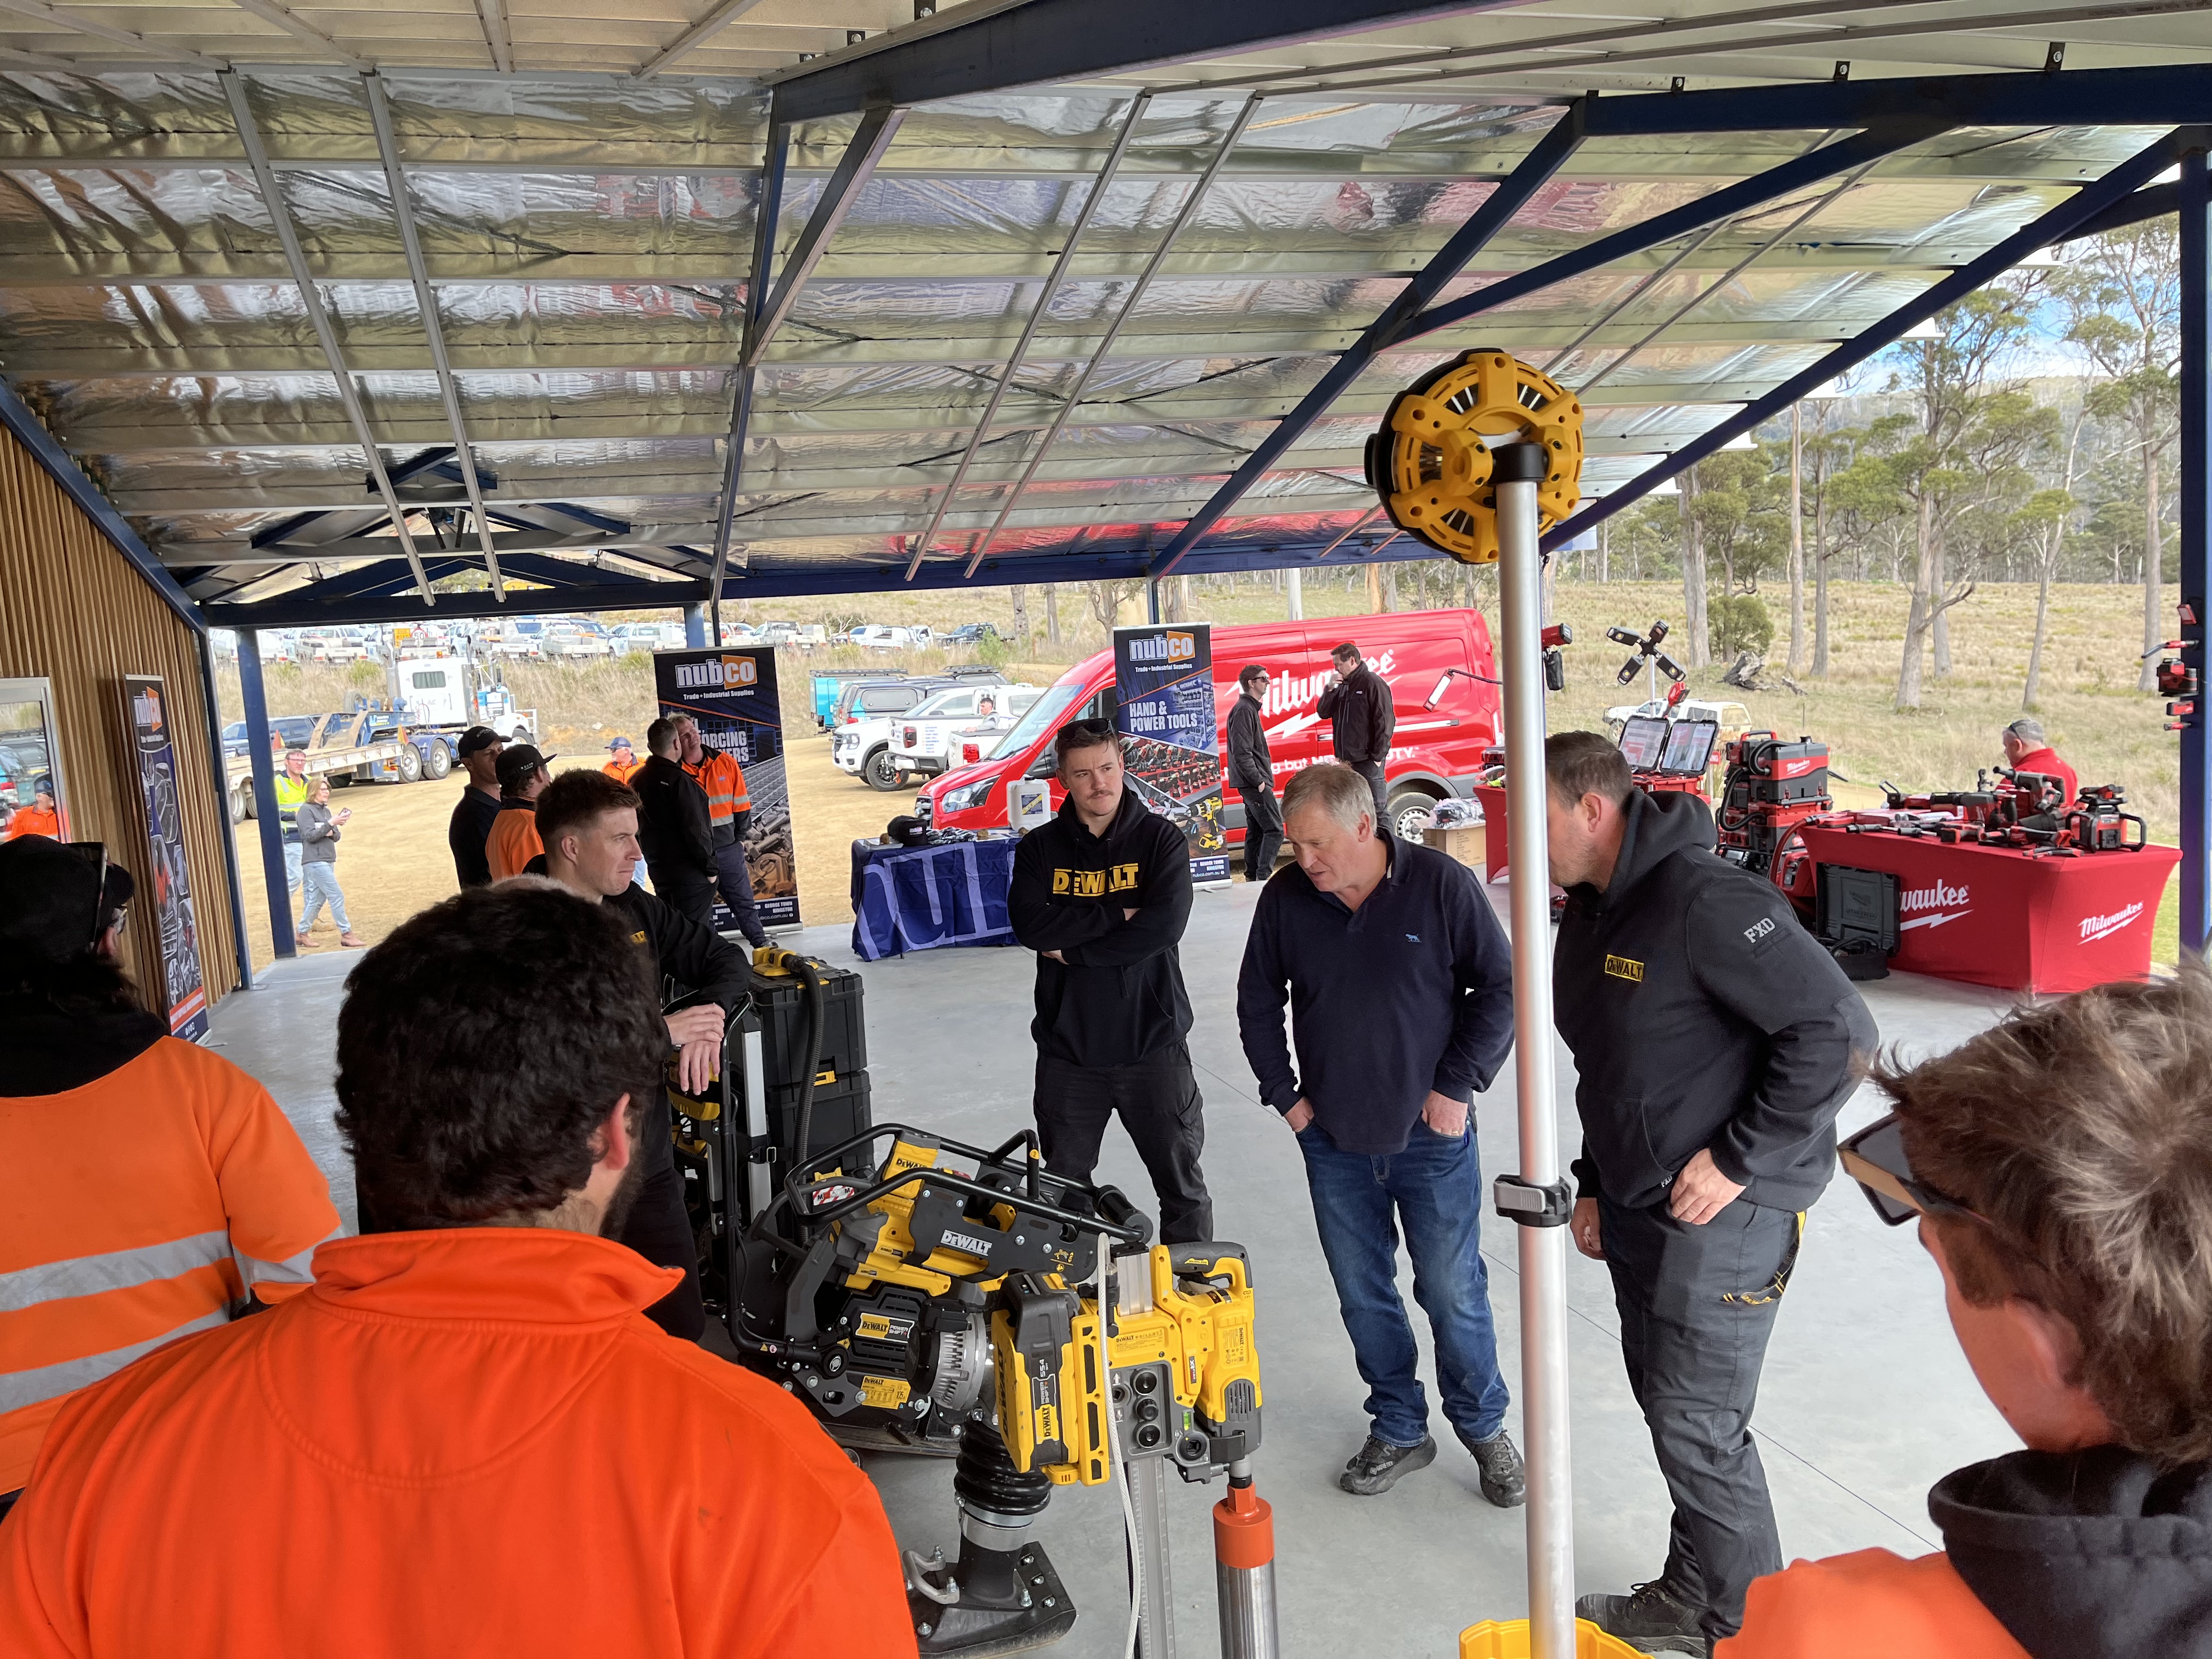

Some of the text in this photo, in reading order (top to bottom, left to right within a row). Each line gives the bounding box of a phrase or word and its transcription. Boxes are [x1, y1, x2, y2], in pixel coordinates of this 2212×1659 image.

[1129, 634, 1194, 662] nubco
[675, 658, 756, 688] nubco
[1129, 701, 1167, 718] HAND &
[1130, 713, 1198, 732] POWER TOOLS
[701, 731, 747, 748] ORCING
[1900, 879, 1970, 912] waukee
[1743, 917, 1775, 944] FXD
[2078, 901, 2143, 938] Milwaukee
[1376, 1460, 1394, 1471] GORE-TEX
